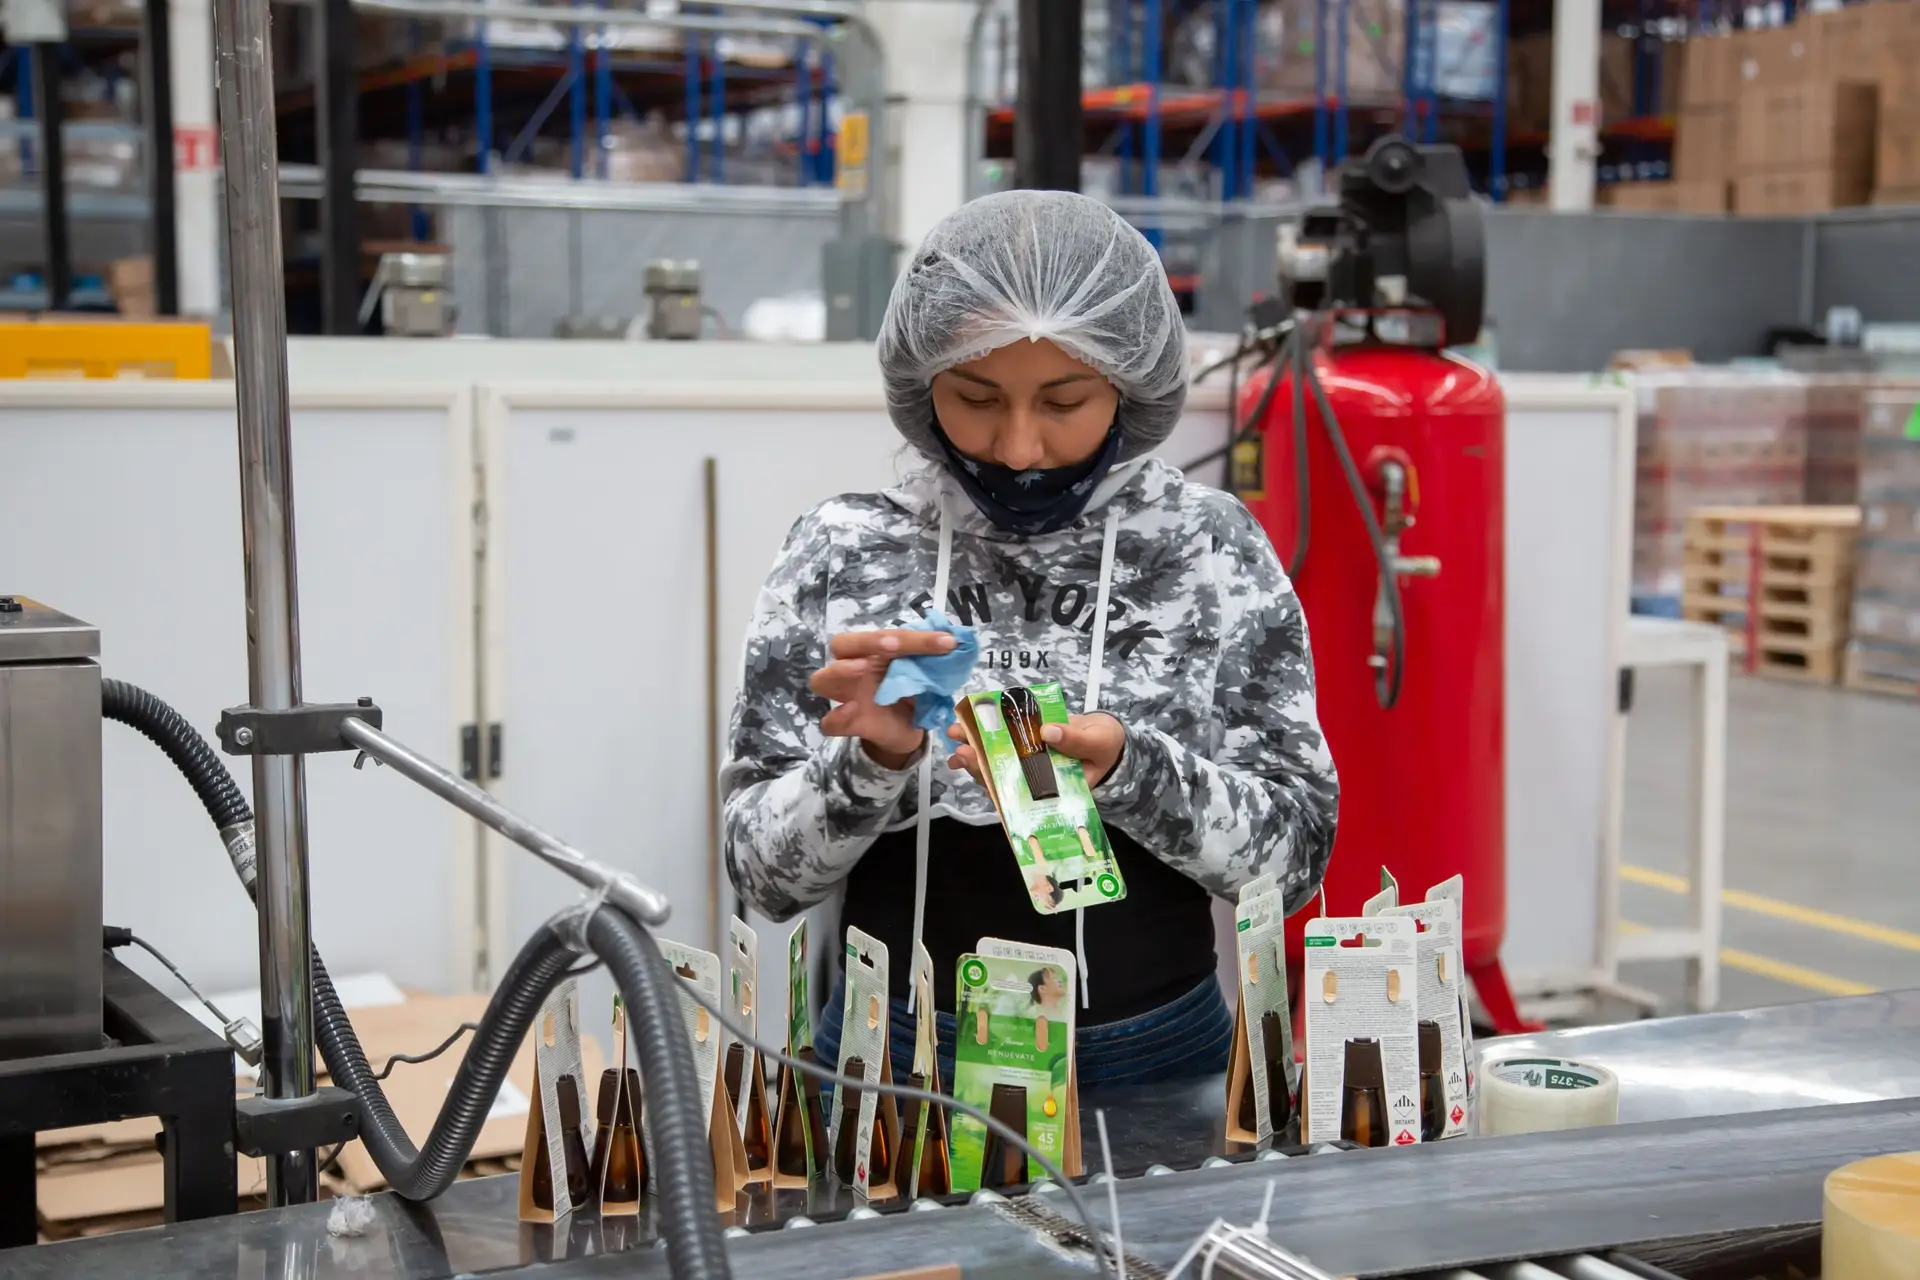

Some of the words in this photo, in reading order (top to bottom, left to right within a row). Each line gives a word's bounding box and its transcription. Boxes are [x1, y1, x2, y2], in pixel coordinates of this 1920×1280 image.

[1016, 574, 1164, 660] YORK
[986, 650, 1049, 669] 199X
[1550, 1075, 1574, 1086] 375
[1038, 1132, 1054, 1144] 45
